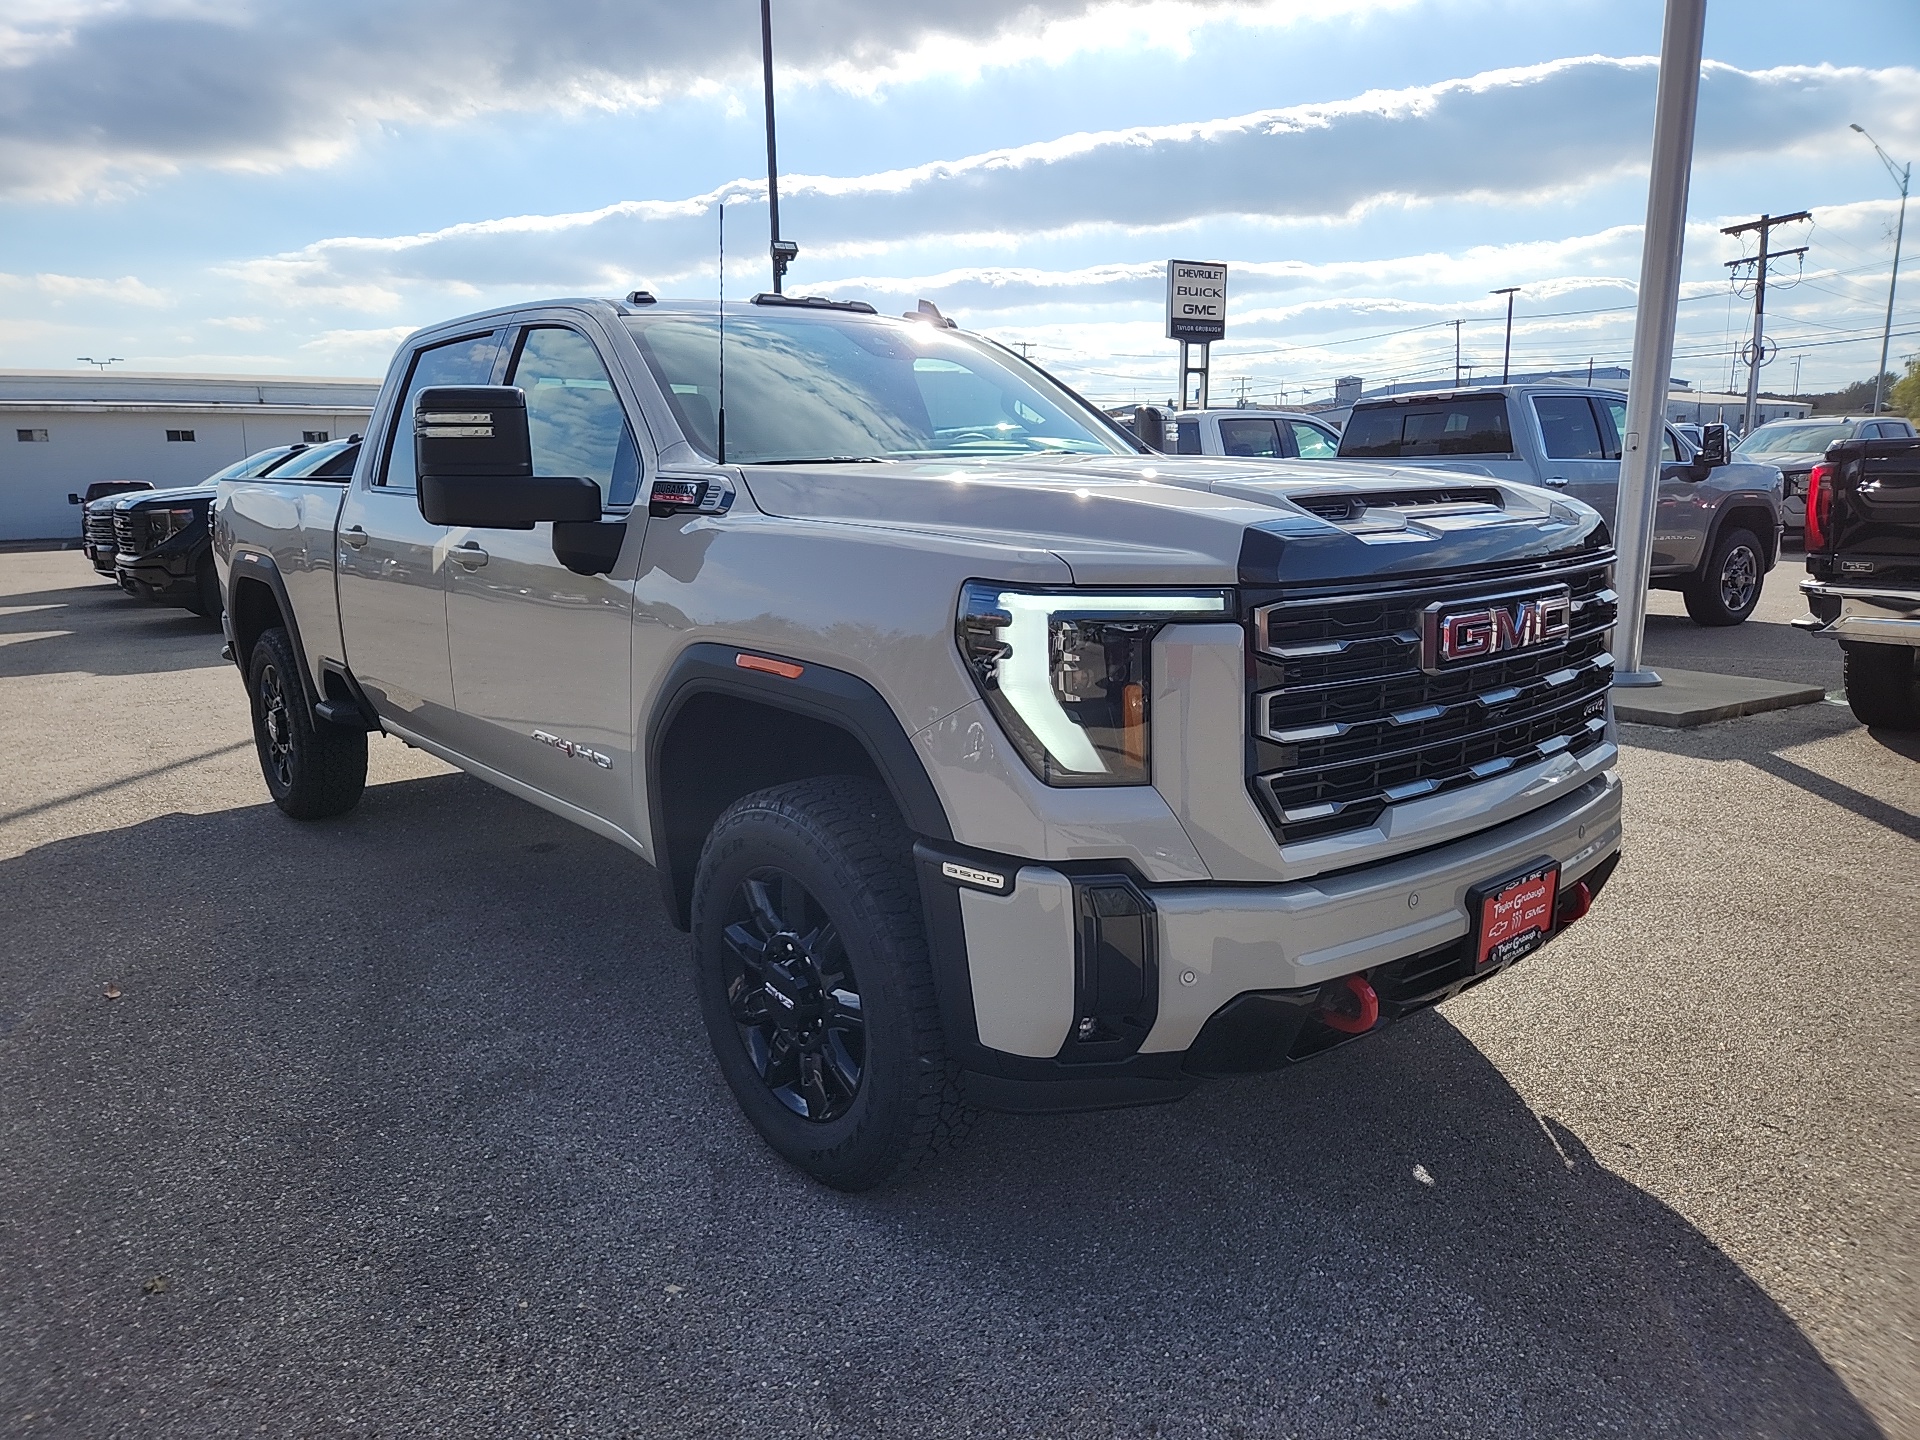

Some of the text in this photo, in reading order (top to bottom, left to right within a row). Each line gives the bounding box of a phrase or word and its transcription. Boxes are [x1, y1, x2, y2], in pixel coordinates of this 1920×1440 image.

[1178, 268, 1223, 281] CHEVROLET
[1177, 285, 1222, 298] BUICK
[1183, 304, 1216, 315] GMC
[1177, 324, 1194, 332] TAYLOR
[656, 483, 698, 496] DURAMAX
[1440, 597, 1570, 661] GMC
[946, 866, 999, 883] 3500
[1493, 886, 1546, 919] Taylor Grubaugh
[1525, 904, 1546, 919] GMC
